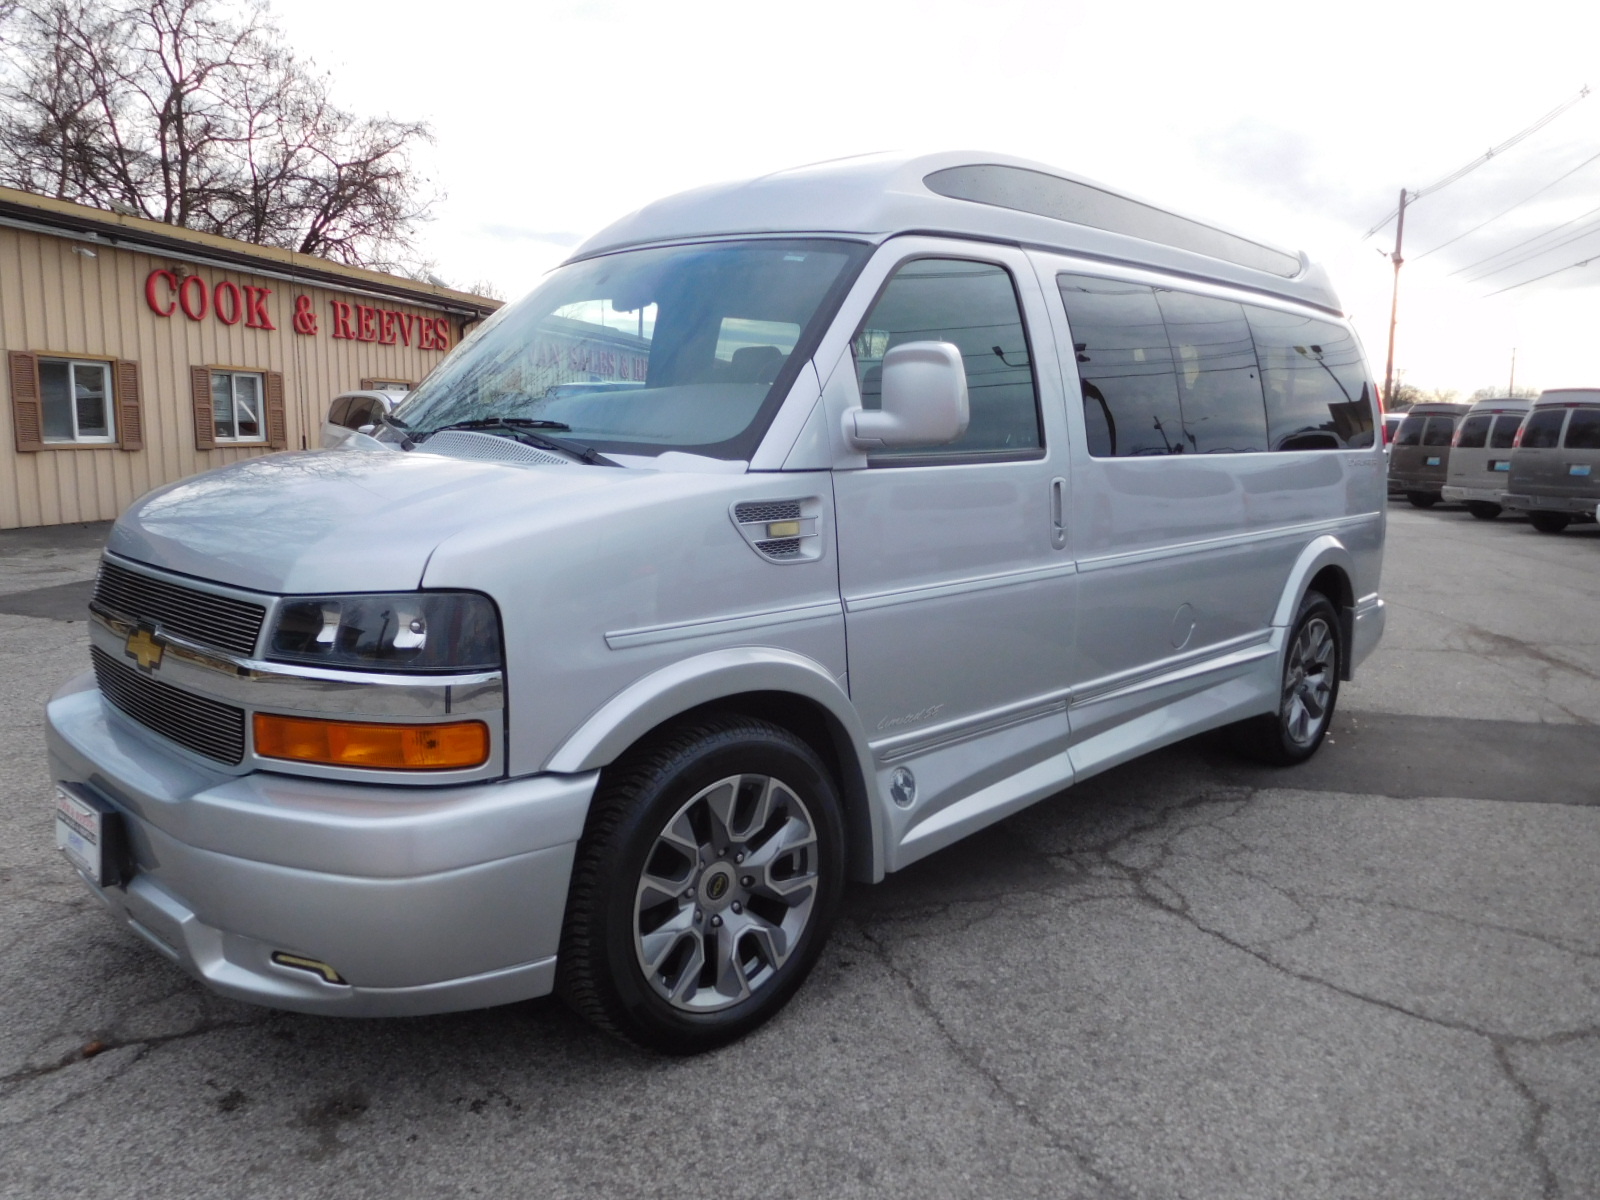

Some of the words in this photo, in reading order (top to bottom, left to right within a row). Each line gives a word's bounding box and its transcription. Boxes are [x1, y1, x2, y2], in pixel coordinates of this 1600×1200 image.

[145, 269, 277, 330] COOK
[293, 294, 318, 335] &
[331, 300, 449, 350] REEVES
[569, 349, 615, 375] SALES
[620, 356, 630, 379] &
